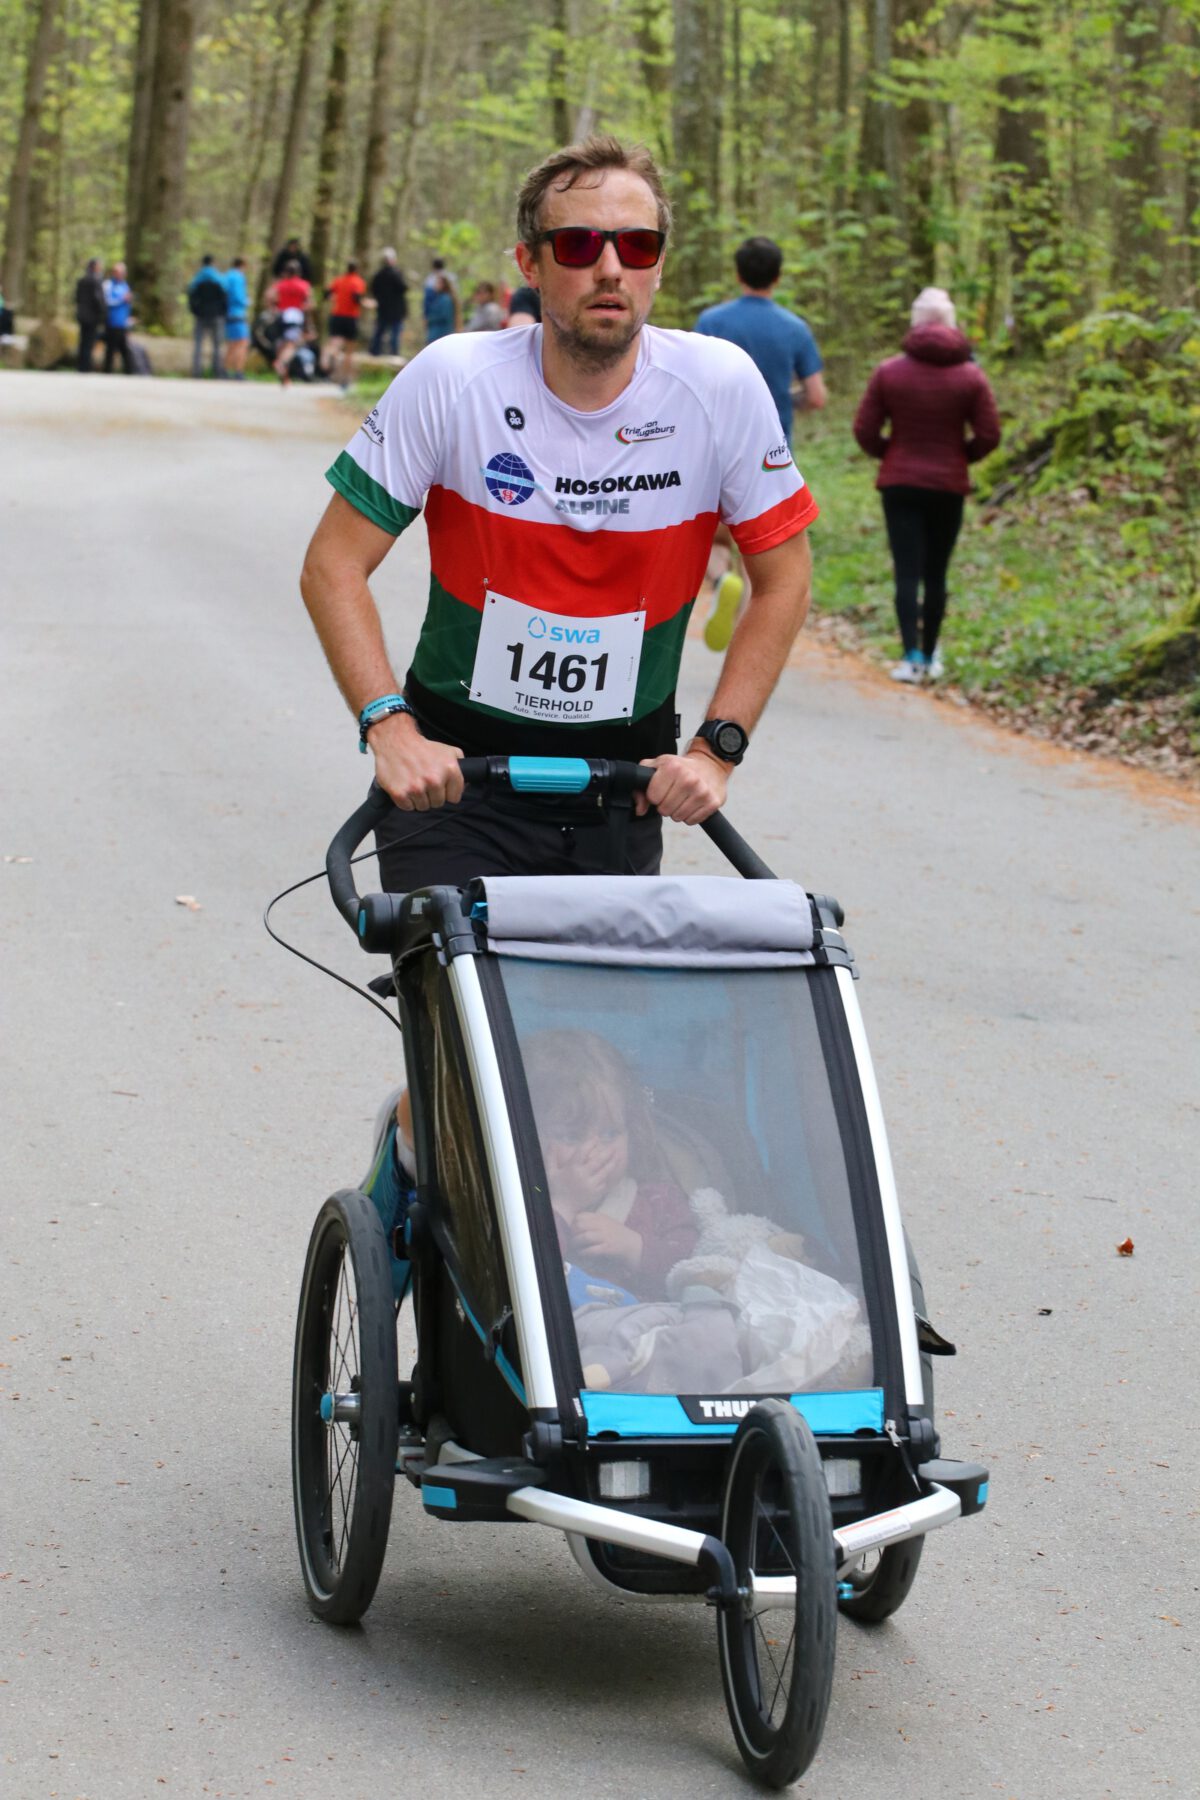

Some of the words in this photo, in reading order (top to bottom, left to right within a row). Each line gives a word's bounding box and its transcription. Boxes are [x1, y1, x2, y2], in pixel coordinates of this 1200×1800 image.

[637, 425, 676, 437] ugsburg
[555, 470, 682, 496] HOSOKAWA
[554, 498, 630, 515] ALPINE
[549, 626, 600, 644] swa
[506, 642, 609, 694] 1461
[514, 691, 594, 712] TIERHOLD
[699, 1400, 758, 1418] THU
